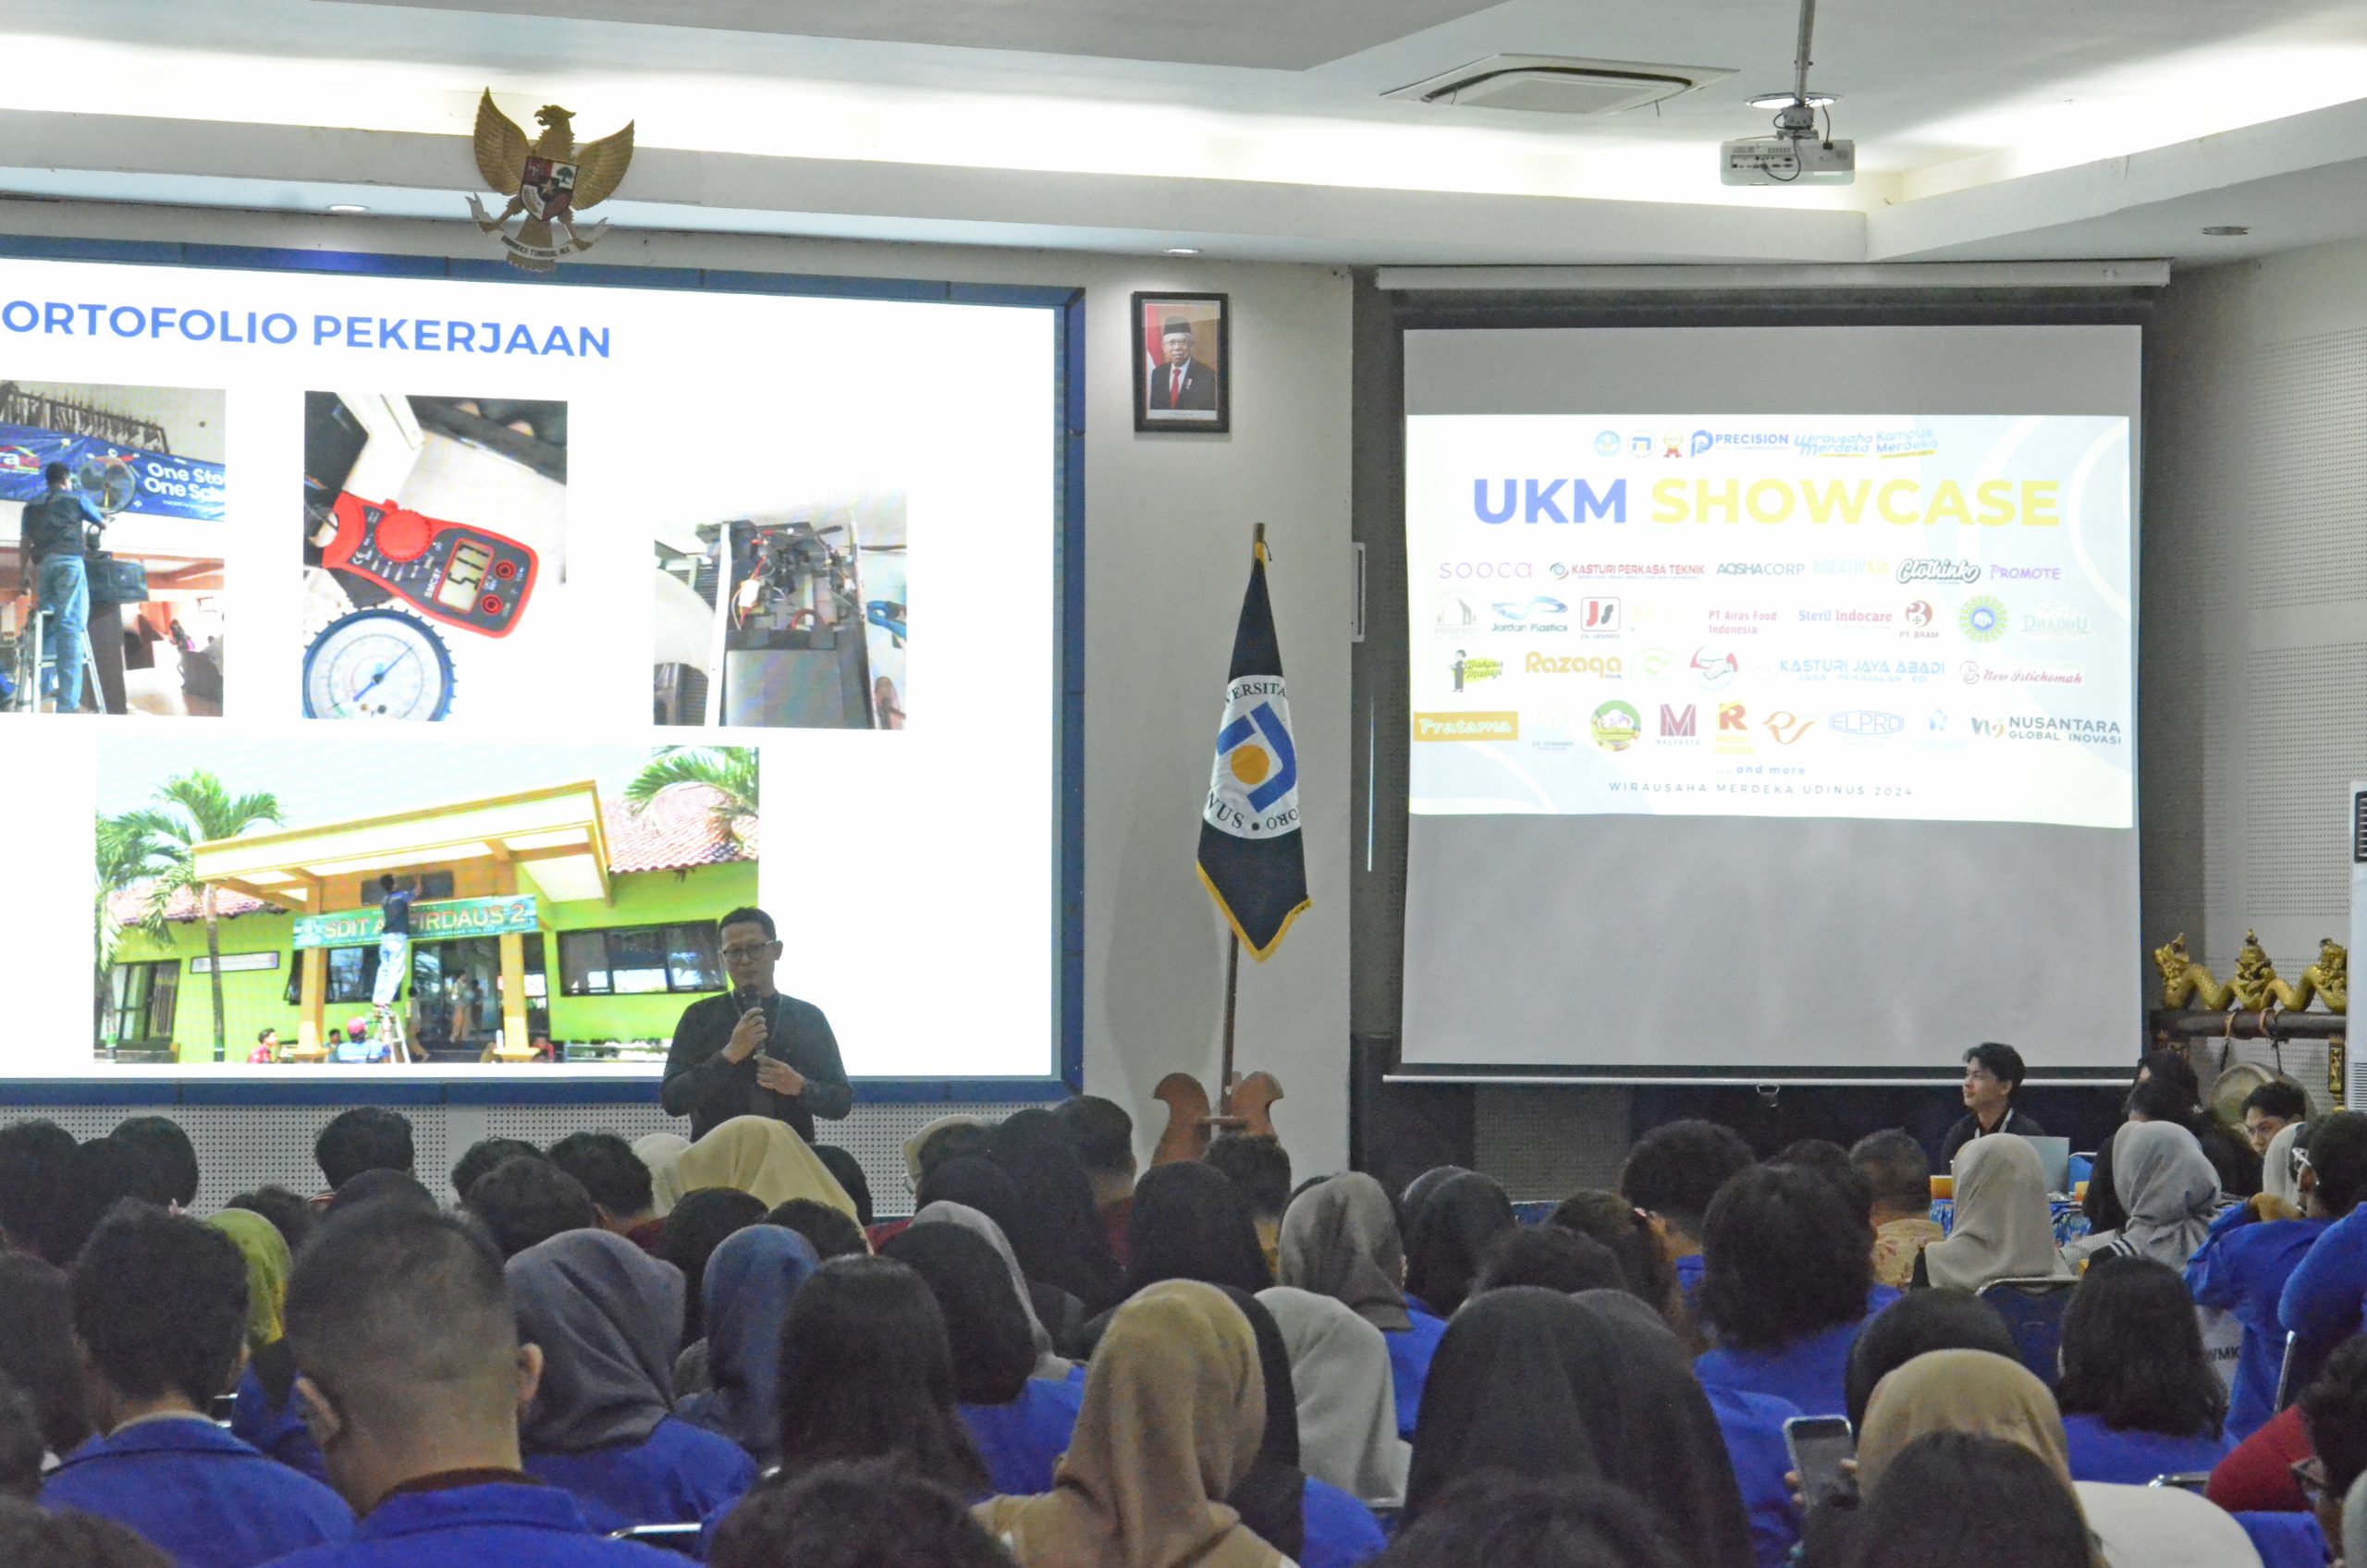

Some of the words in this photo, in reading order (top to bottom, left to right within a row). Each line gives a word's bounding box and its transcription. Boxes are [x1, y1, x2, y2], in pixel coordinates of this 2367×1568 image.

[2, 300, 297, 345] ORTOFOLIO
[313, 314, 610, 358] PEKERJAAN
[1715, 434, 1789, 445] PRECISION
[1876, 428, 1935, 442] Kampus
[148, 462, 190, 481] One
[144, 477, 186, 497] One
[1473, 478, 1627, 524] UKM
[1650, 478, 2060, 527] SHOWCASE
[1572, 564, 1616, 574] KASTURI
[1618, 564, 1666, 574] PERKASA
[1669, 564, 1705, 574] TEKNIK
[1991, 564, 2061, 581] PROMOTE
[1709, 611, 1720, 620] PT
[1724, 610, 1749, 621] Airas
[1753, 610, 1777, 621] Food
[1798, 609, 1832, 621] Steril
[1835, 609, 1893, 622] Indocare
[1490, 623, 1527, 632] Jordan
[1530, 623, 1569, 632] Plastics
[1709, 624, 1758, 634] Indonesia
[1779, 659, 1848, 672] KASTURI
[1852, 659, 1891, 673] JAYA
[1895, 660, 1945, 675] ABADI
[1983, 668, 2008, 681] New
[2009, 717, 2122, 734] NUSANTARA
[2009, 730, 2060, 741] GLOBAL
[2068, 733, 2122, 745] INOVASI
[1736, 765, 1763, 774] and
[1769, 766, 1806, 775] more
[1608, 781, 1708, 792] WIRAUSAHA
[1716, 783, 1794, 794] MERDEKA
[1803, 784, 1865, 796] UDINUS
[1874, 785, 1913, 796] 2024
[510, 903, 527, 924] 2
[325, 918, 368, 939] SDIT
